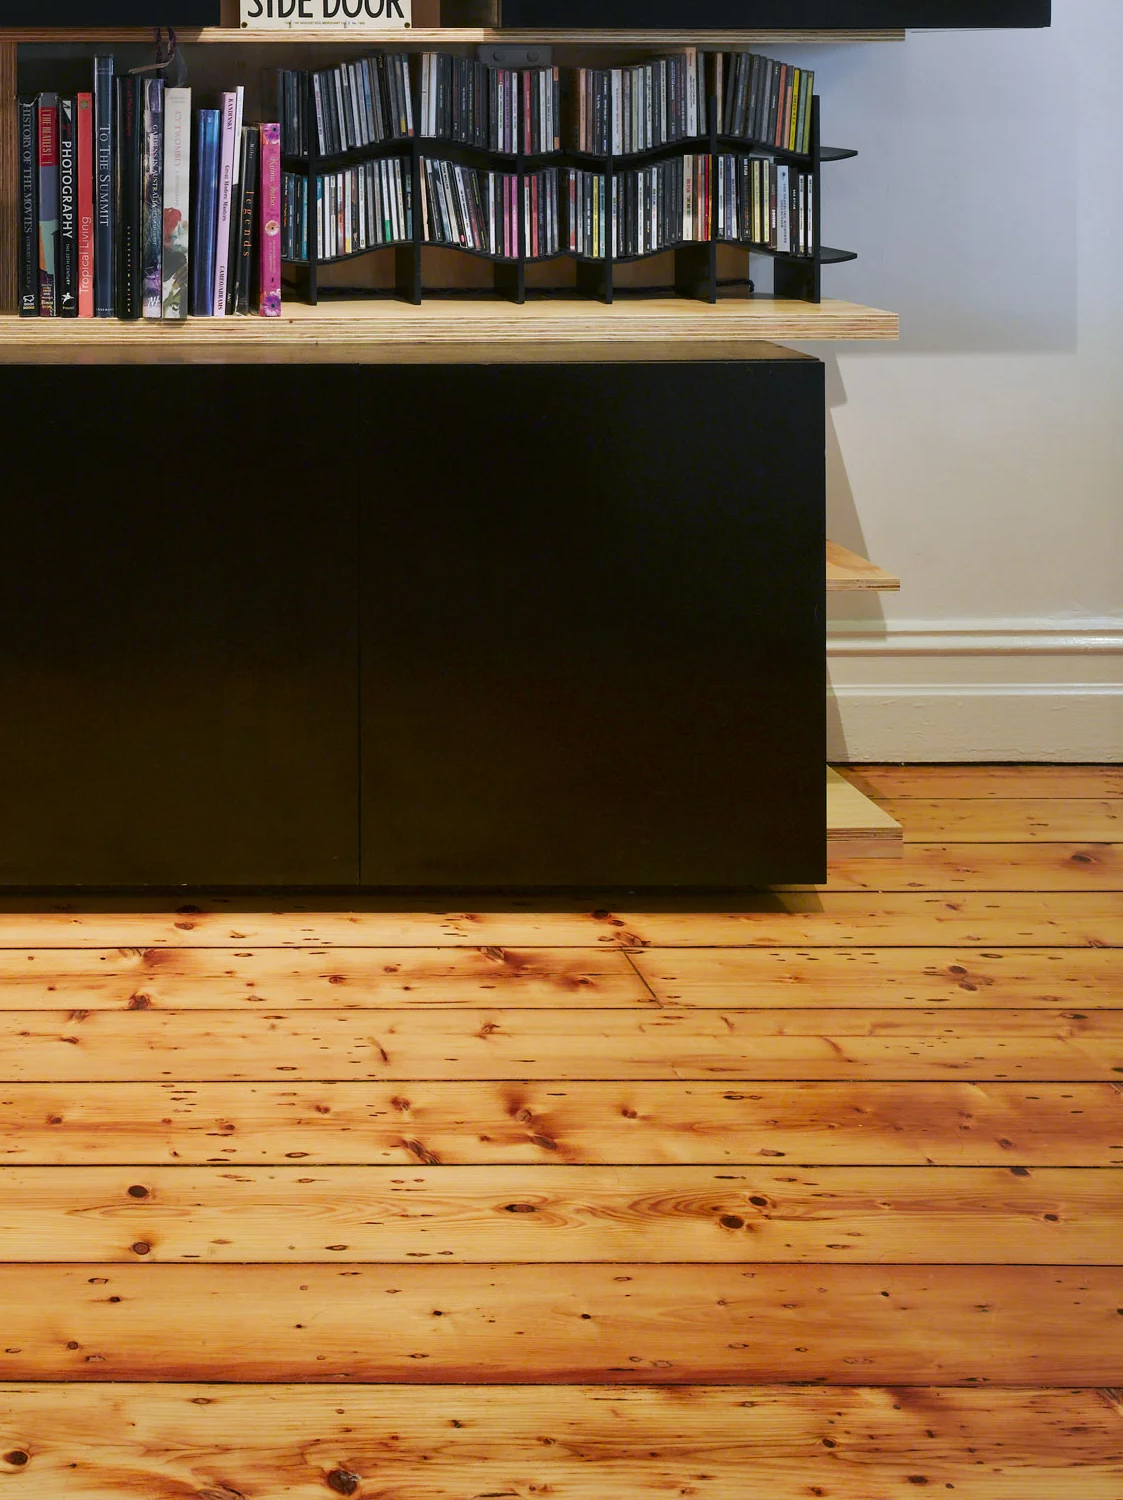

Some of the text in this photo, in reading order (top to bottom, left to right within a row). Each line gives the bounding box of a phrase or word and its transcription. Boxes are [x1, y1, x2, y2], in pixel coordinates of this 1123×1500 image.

[24, 167, 33, 233] THE MOVIES
[62, 141, 73, 238] PHOTOGRAPHY
[242, 191, 255, 257] legends
[78, 216, 93, 294] Tropical Living
